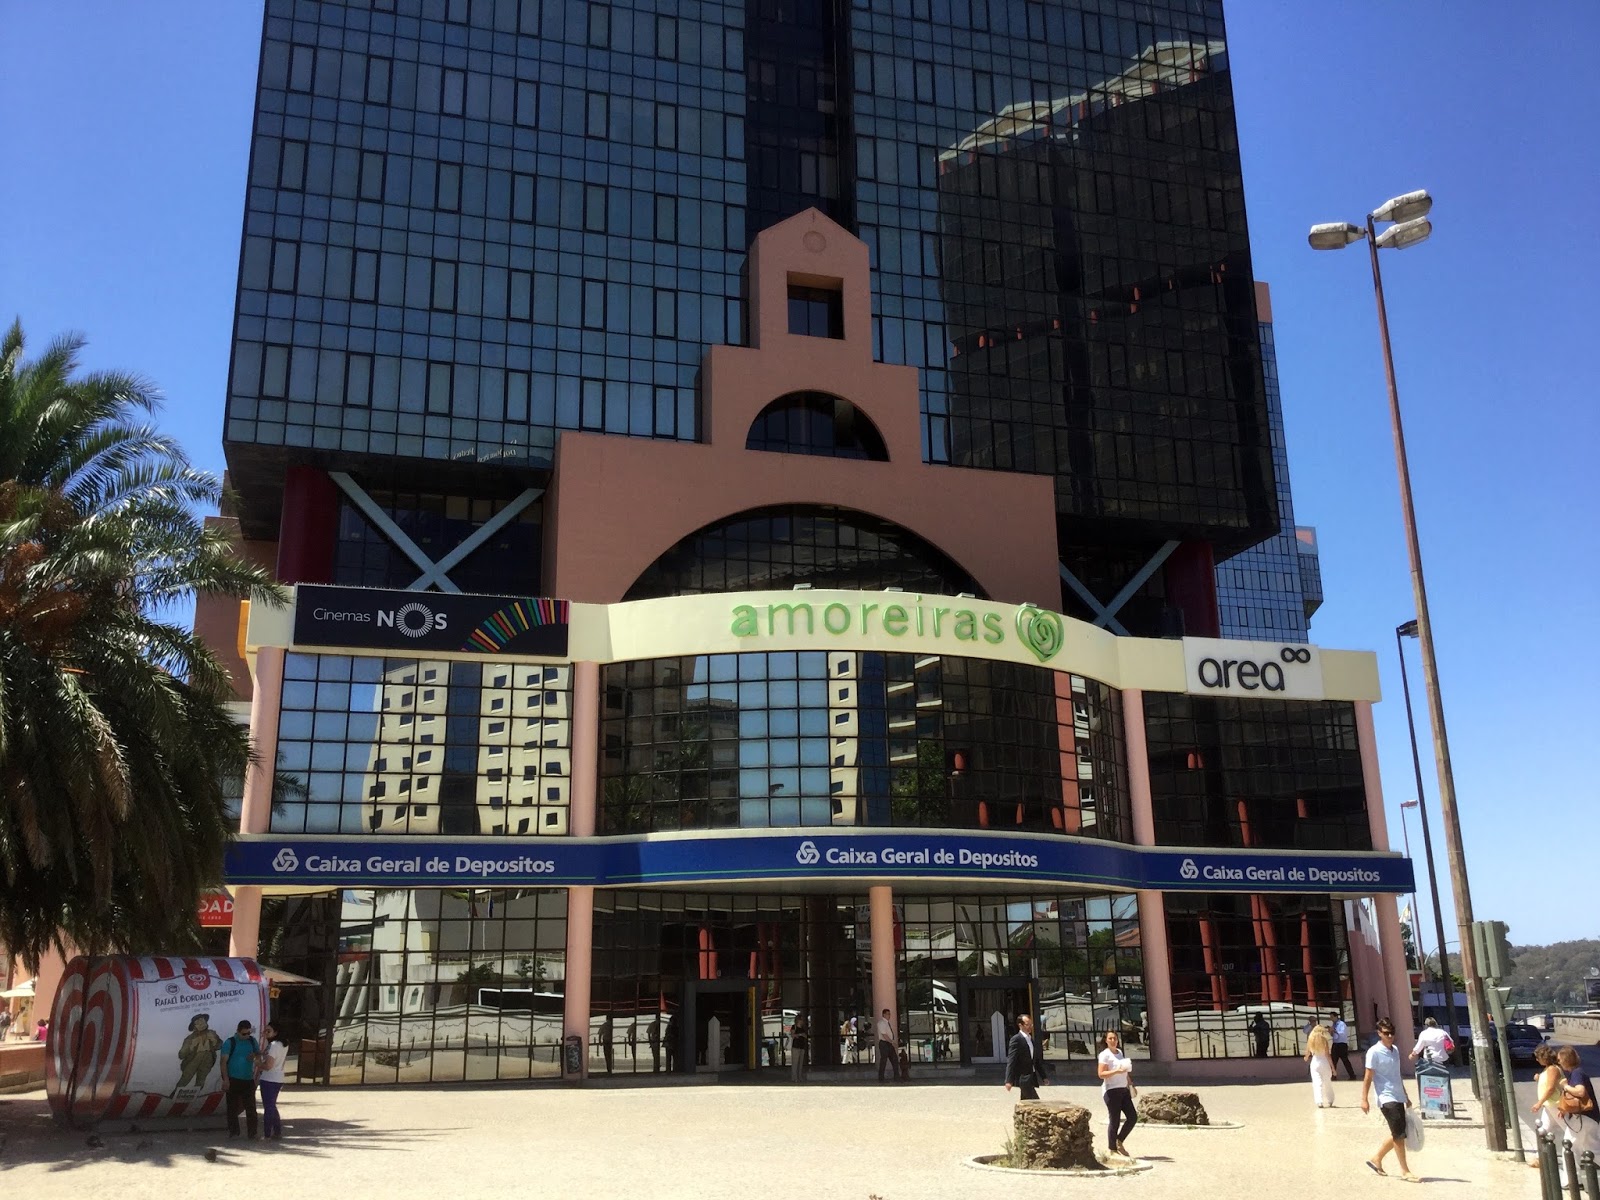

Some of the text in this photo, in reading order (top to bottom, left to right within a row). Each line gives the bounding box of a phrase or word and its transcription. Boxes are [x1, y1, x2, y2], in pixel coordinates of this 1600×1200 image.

[313, 602, 447, 638] Cinemas NOS
[730, 595, 1005, 644] amoreiras
[1198, 658, 1285, 691] area
[305, 855, 361, 872] Caixa
[366, 856, 420, 873] Geral
[425, 856, 449, 873] de
[826, 848, 877, 864] Caixa
[881, 848, 929, 864] Geral
[933, 848, 954, 865] de
[1203, 865, 1243, 880] Caixa
[1246, 866, 1285, 881] Geral
[1288, 867, 1305, 881] de
